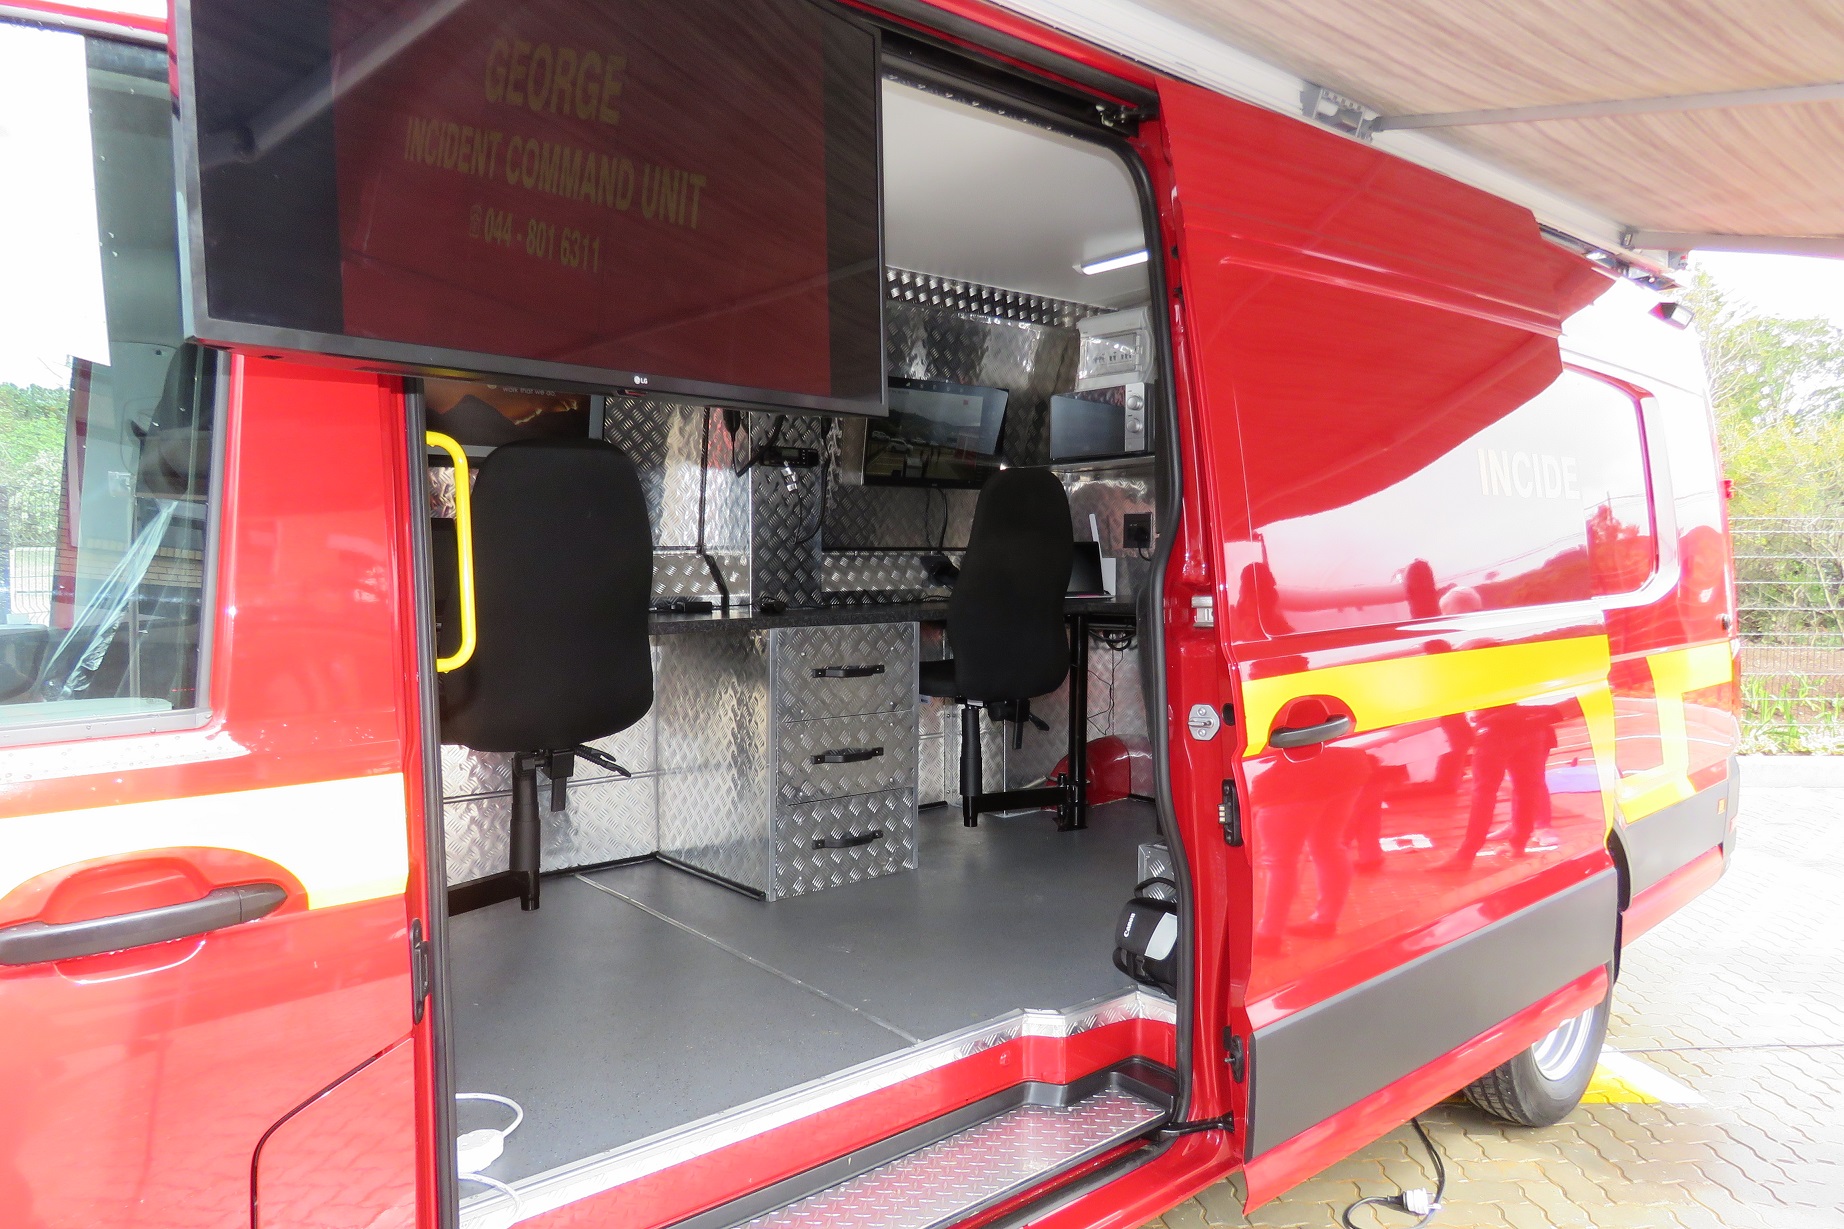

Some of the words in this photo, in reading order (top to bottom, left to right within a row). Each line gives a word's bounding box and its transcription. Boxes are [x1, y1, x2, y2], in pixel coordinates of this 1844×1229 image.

[484, 36, 628, 126] GEORGE
[404, 116, 503, 179] INCIDENT
[505, 134, 635, 212] COMMAND
[641, 164, 708, 230] UNIT
[484, 207, 512, 248] 044
[526, 217, 555, 261] 801
[560, 226, 600, 273] 6311
[534, 388, 545, 396] we
[1477, 448, 1582, 500] INCIDE
[1123, 912, 1136, 938] Canon
